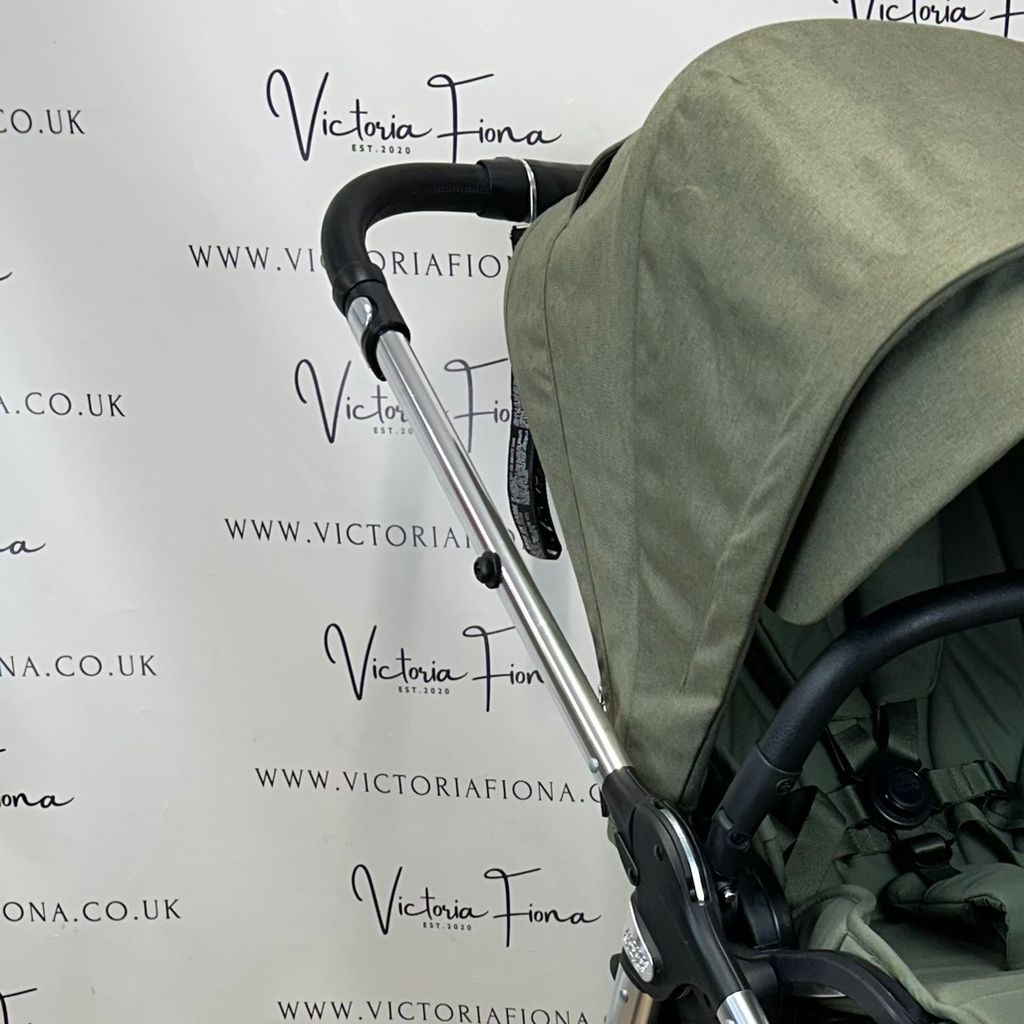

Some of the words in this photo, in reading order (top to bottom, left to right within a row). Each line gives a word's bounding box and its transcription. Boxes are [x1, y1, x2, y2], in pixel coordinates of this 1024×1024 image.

[265, 68, 432, 163] Victoria
[426, 72, 563, 162] Fiona
[351, 143, 412, 156] EST.2020
[323, 622, 470, 702] Victoria
[397, 685, 450, 696] EST.2020
[350, 863, 490, 936] Victoria
[482, 867, 602, 949] Fiona
[422, 921, 472, 932] EST.2020
